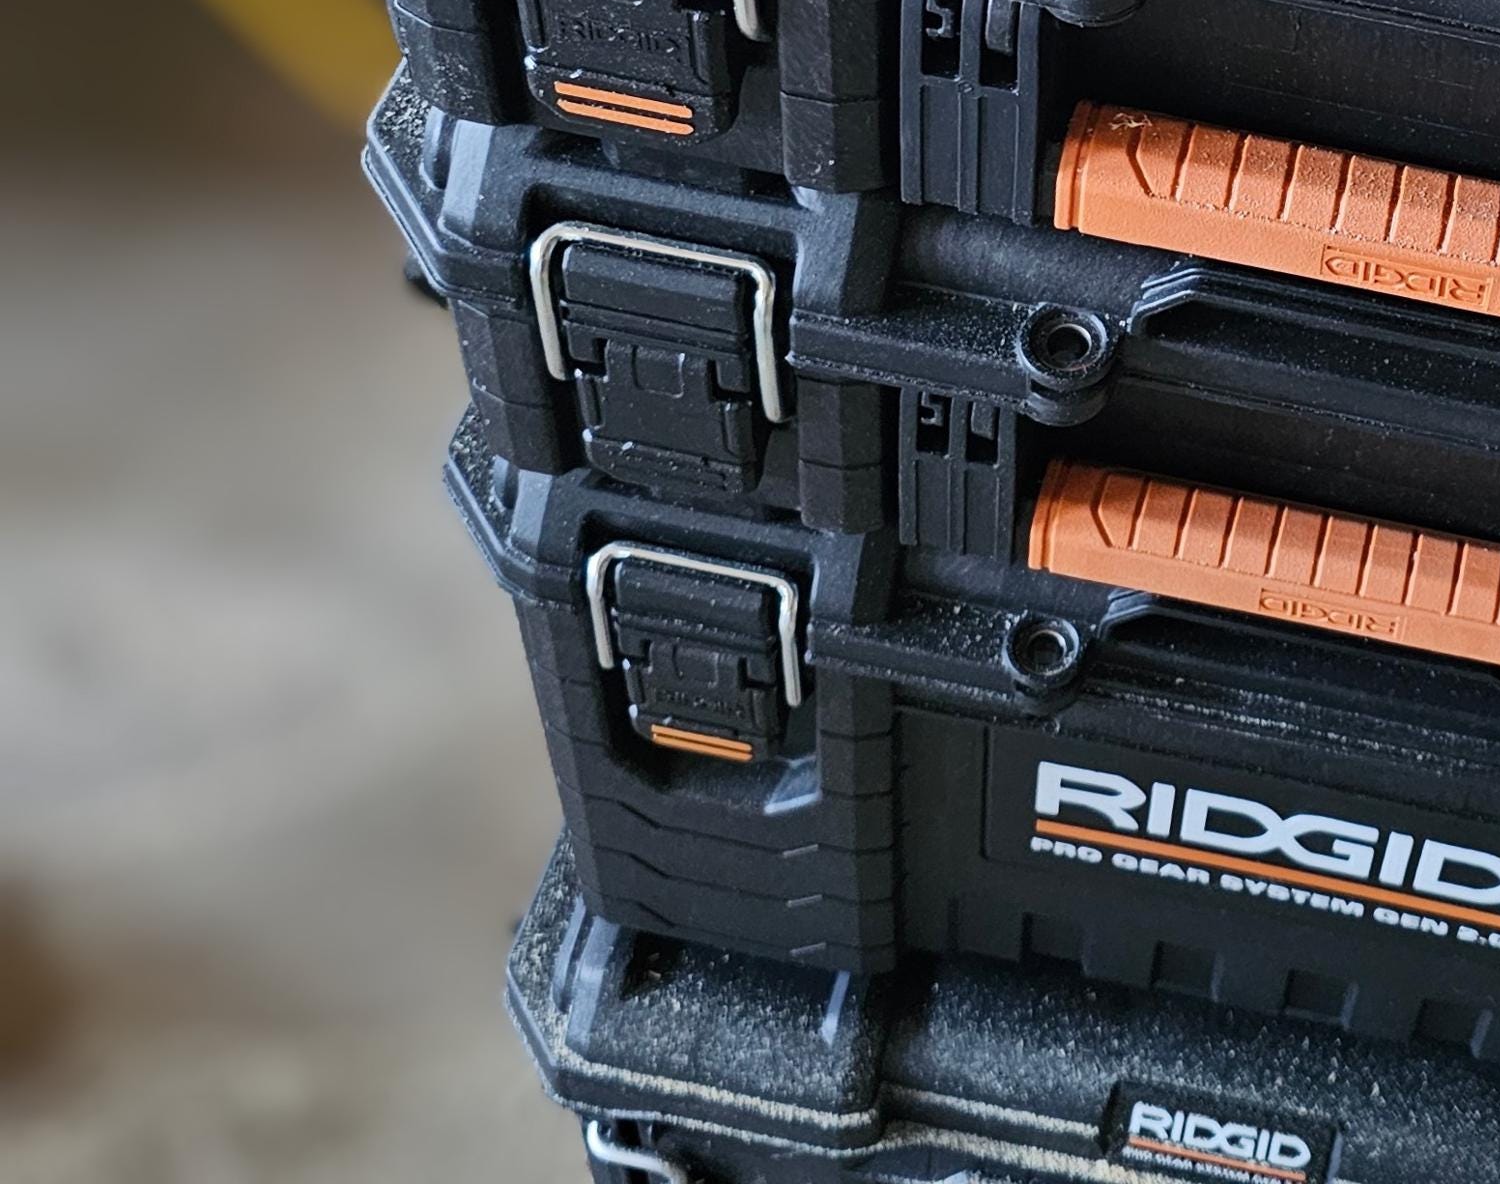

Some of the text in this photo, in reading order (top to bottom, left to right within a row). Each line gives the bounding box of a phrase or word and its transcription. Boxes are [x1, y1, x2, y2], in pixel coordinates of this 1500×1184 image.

[1324, 255, 1485, 304] RIDGID
[1260, 596, 1396, 634] RIDGID
[1030, 836, 1103, 864] PRO
[1111, 852, 1211, 885] GEAR
[1220, 873, 1365, 917] SYSTEM
[1373, 907, 1449, 936] GEN
[1129, 1101, 1311, 1168] RIDGID
